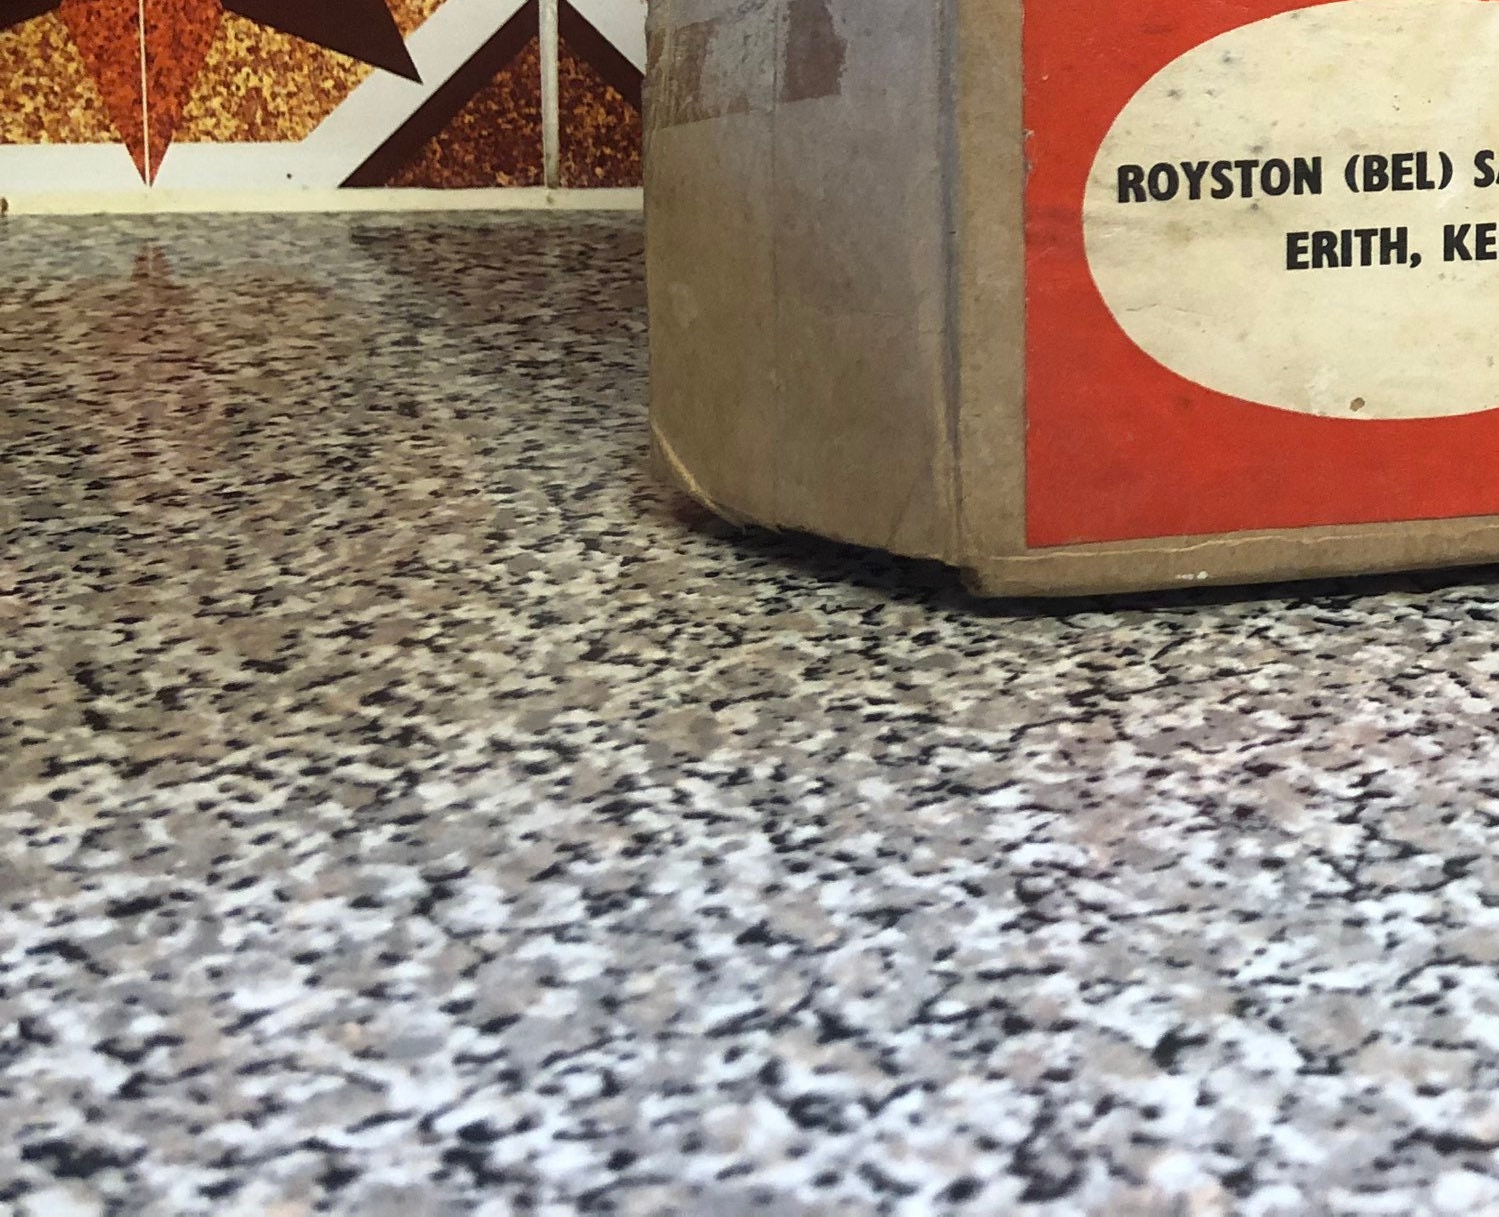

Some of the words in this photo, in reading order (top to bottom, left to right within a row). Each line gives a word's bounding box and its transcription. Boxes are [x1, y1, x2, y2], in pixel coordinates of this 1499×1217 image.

[1117, 156, 1322, 204] ROYSTON
[1345, 149, 1454, 193] (BEL)
[1285, 226, 1422, 270] ERITH,
